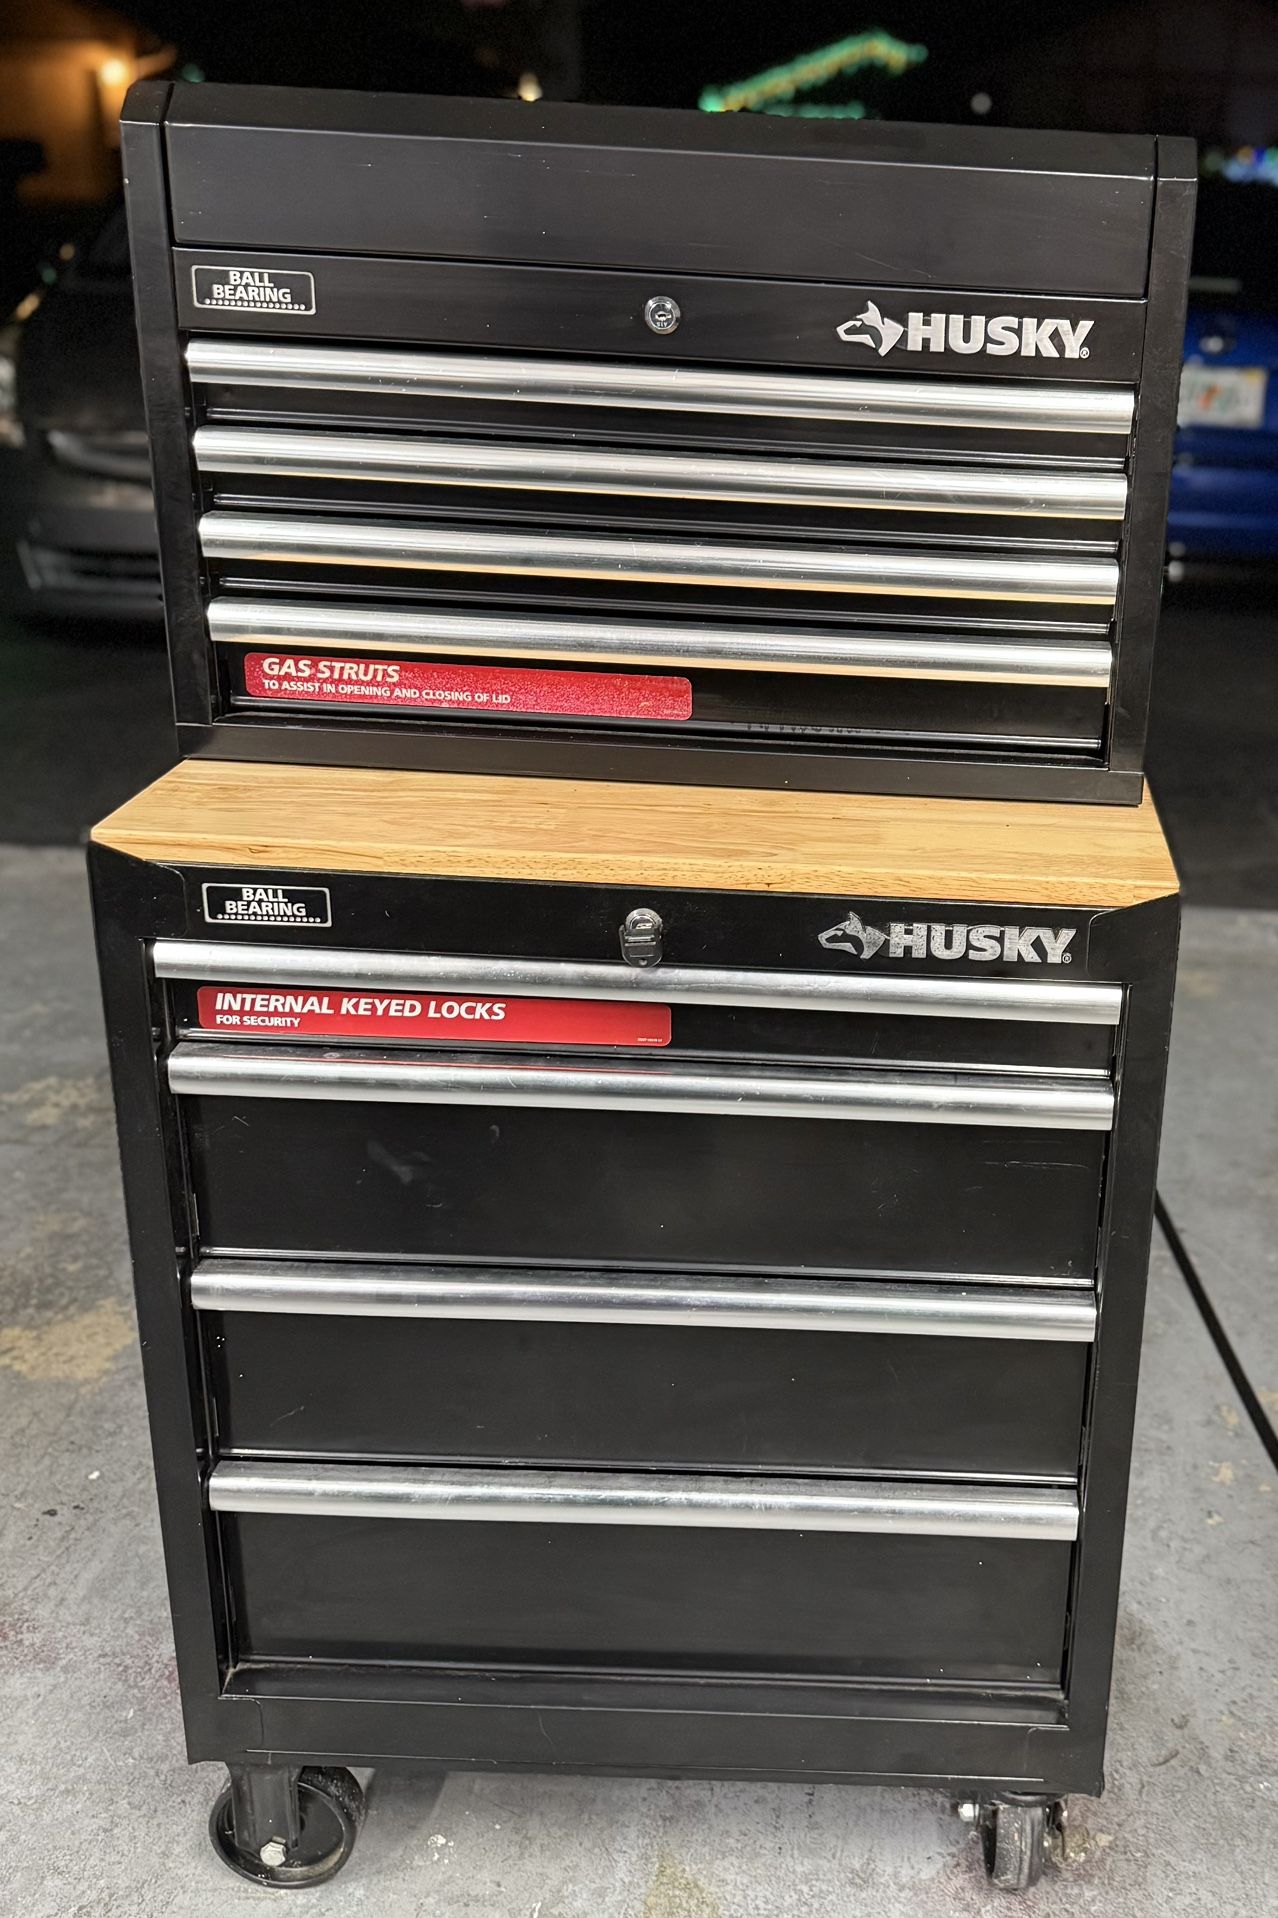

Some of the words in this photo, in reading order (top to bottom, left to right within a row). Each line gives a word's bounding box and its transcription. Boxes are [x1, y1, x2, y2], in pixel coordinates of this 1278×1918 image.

[229, 270, 274, 287] BALL
[212, 284, 291, 302] BEARING
[262, 657, 312, 678] GAS
[317, 660, 401, 683] STRUTS
[263, 679, 279, 689] TO
[281, 680, 320, 692] ASSIST
[323, 683, 336, 693] IN
[338, 684, 391, 697] OPENING
[393, 688, 420, 699] AND
[421, 689, 472, 702] CLOSING
[474, 693, 489, 703] OF
[491, 694, 511, 704] LID
[242, 888, 289, 902] BALL
[225, 900, 306, 916] BEARING
[215, 992, 335, 1014] INTERNAL
[340, 997, 422, 1017] KEYED
[427, 1000, 507, 1020] LOCKS
[216, 1014, 241, 1026] FOR
[243, 1015, 300, 1028] SECURITY
